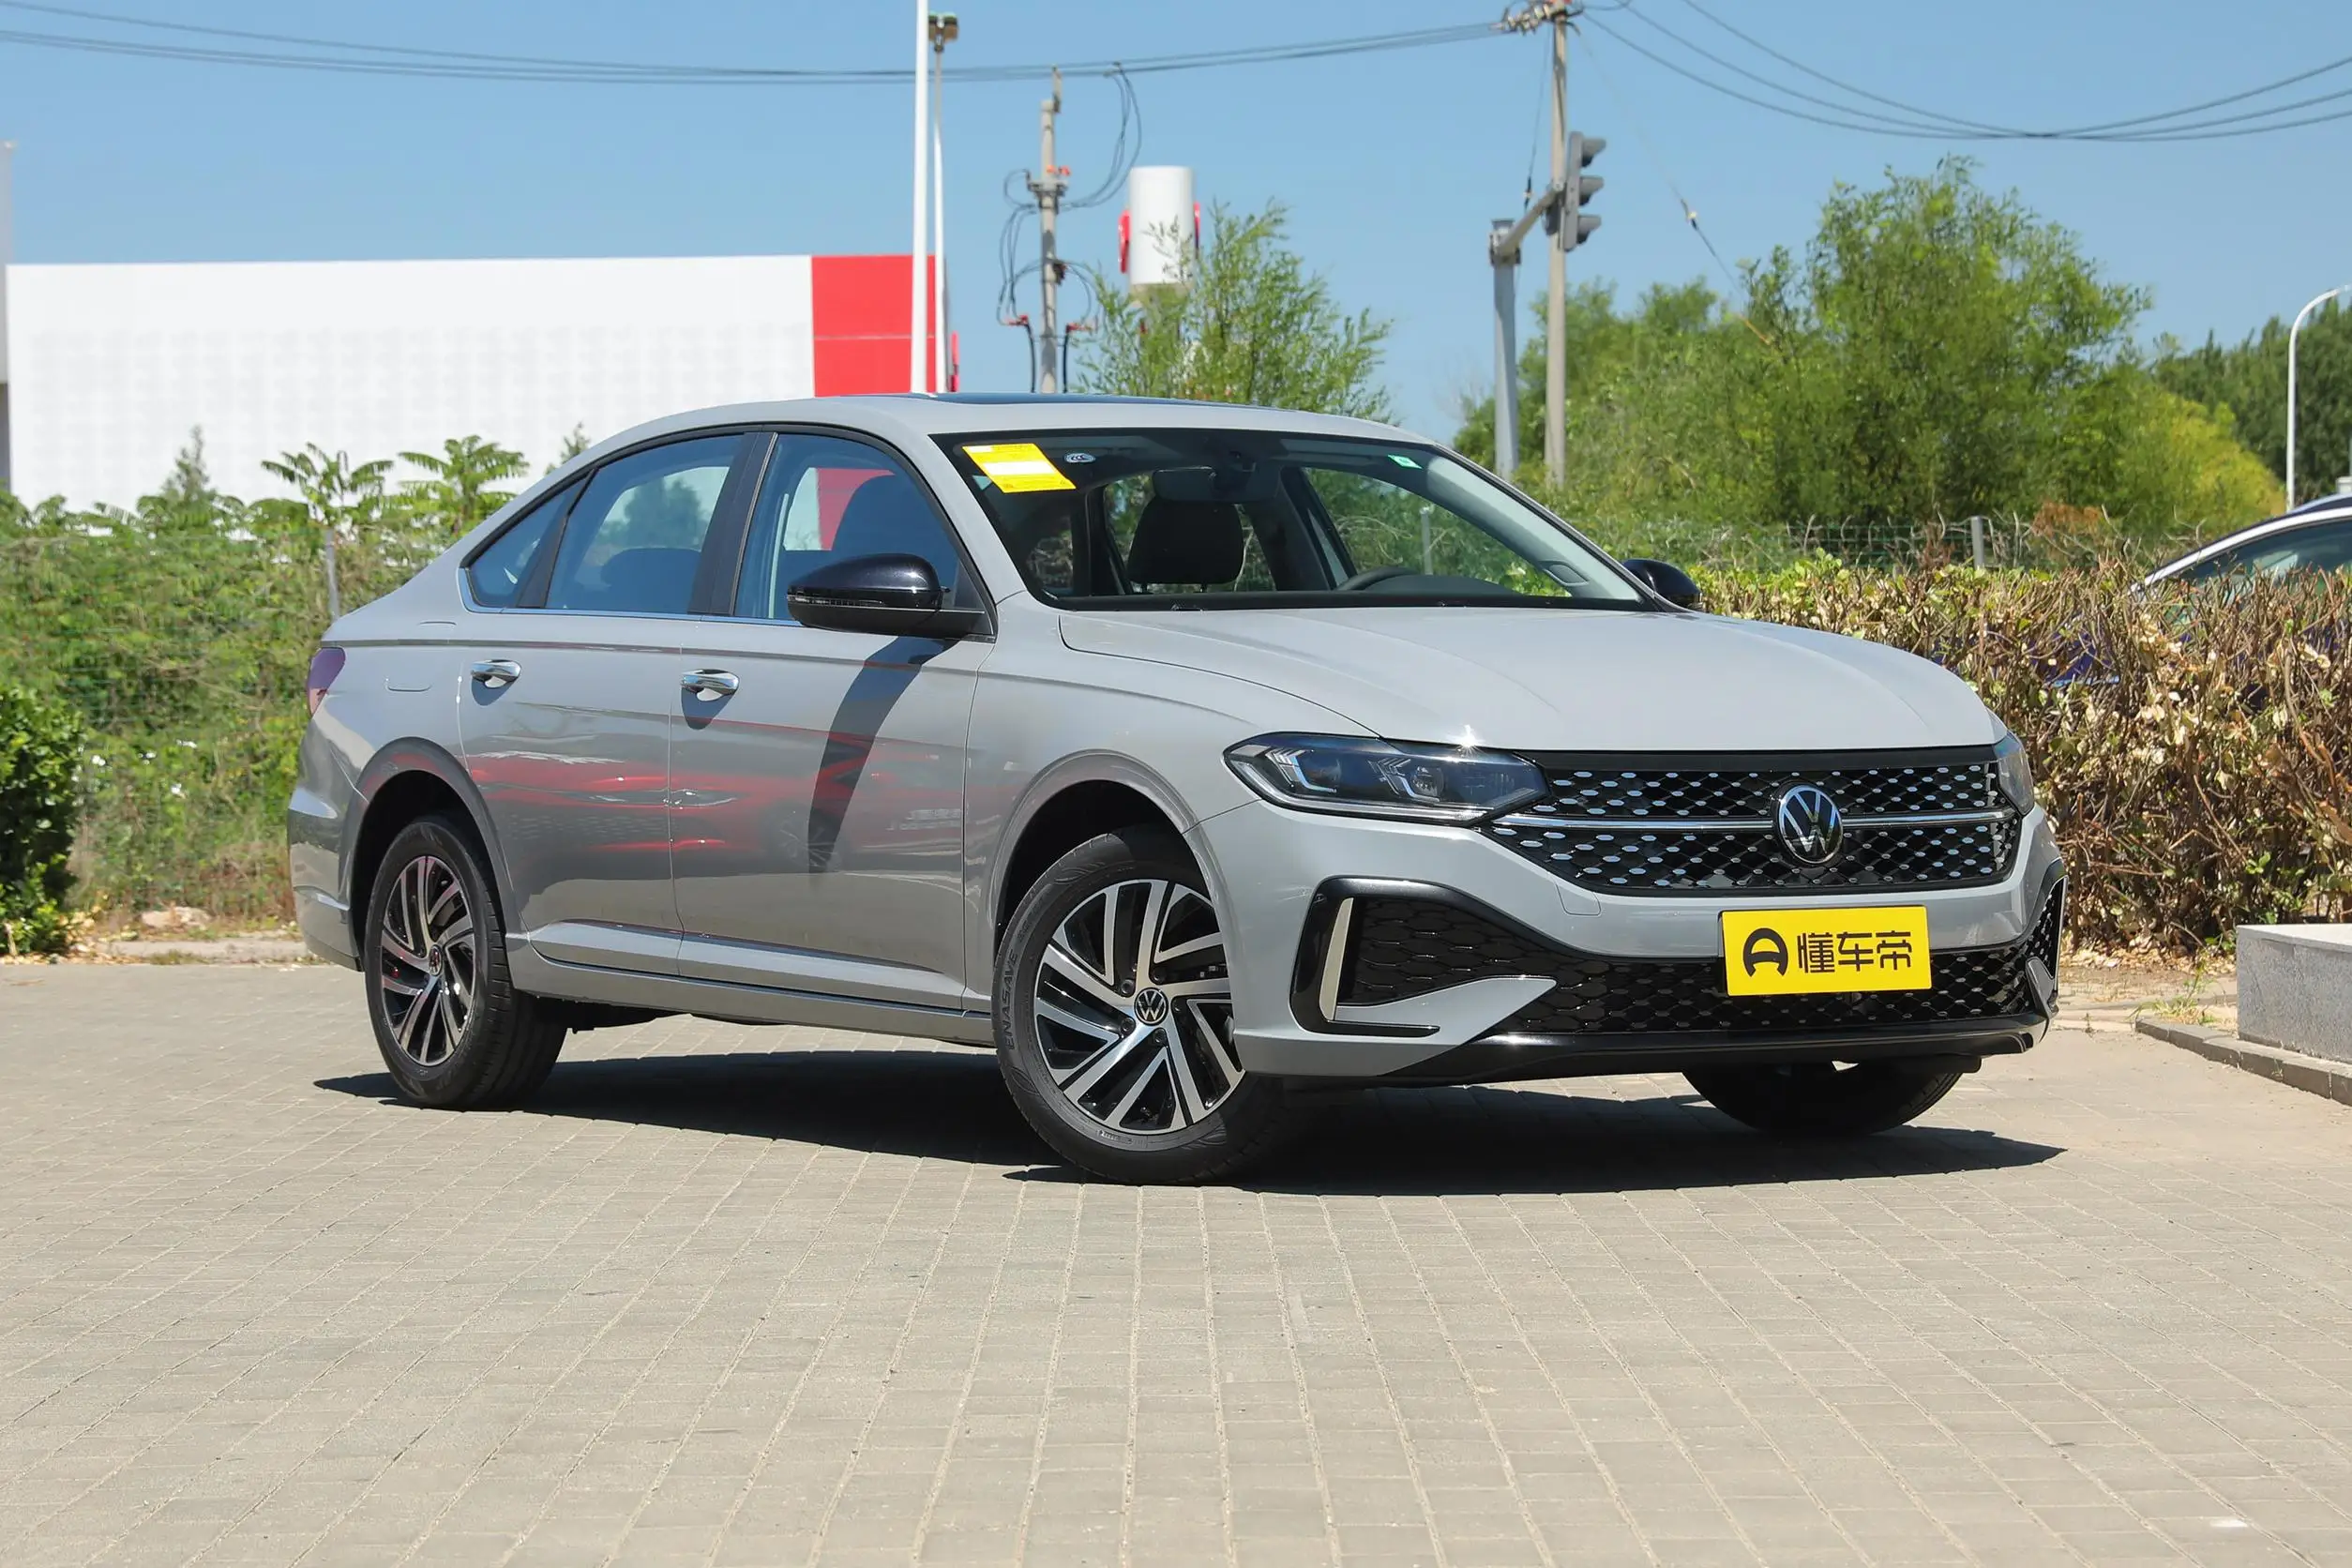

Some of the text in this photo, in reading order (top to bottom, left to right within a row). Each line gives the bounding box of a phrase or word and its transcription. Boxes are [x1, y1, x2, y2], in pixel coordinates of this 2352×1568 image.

[1781, 788, 1839, 857] VW
[1797, 930, 1912, 973] 懂车帝
[1001, 949, 1018, 1050] ENASAVE
[1137, 990, 1165, 1021] VW
